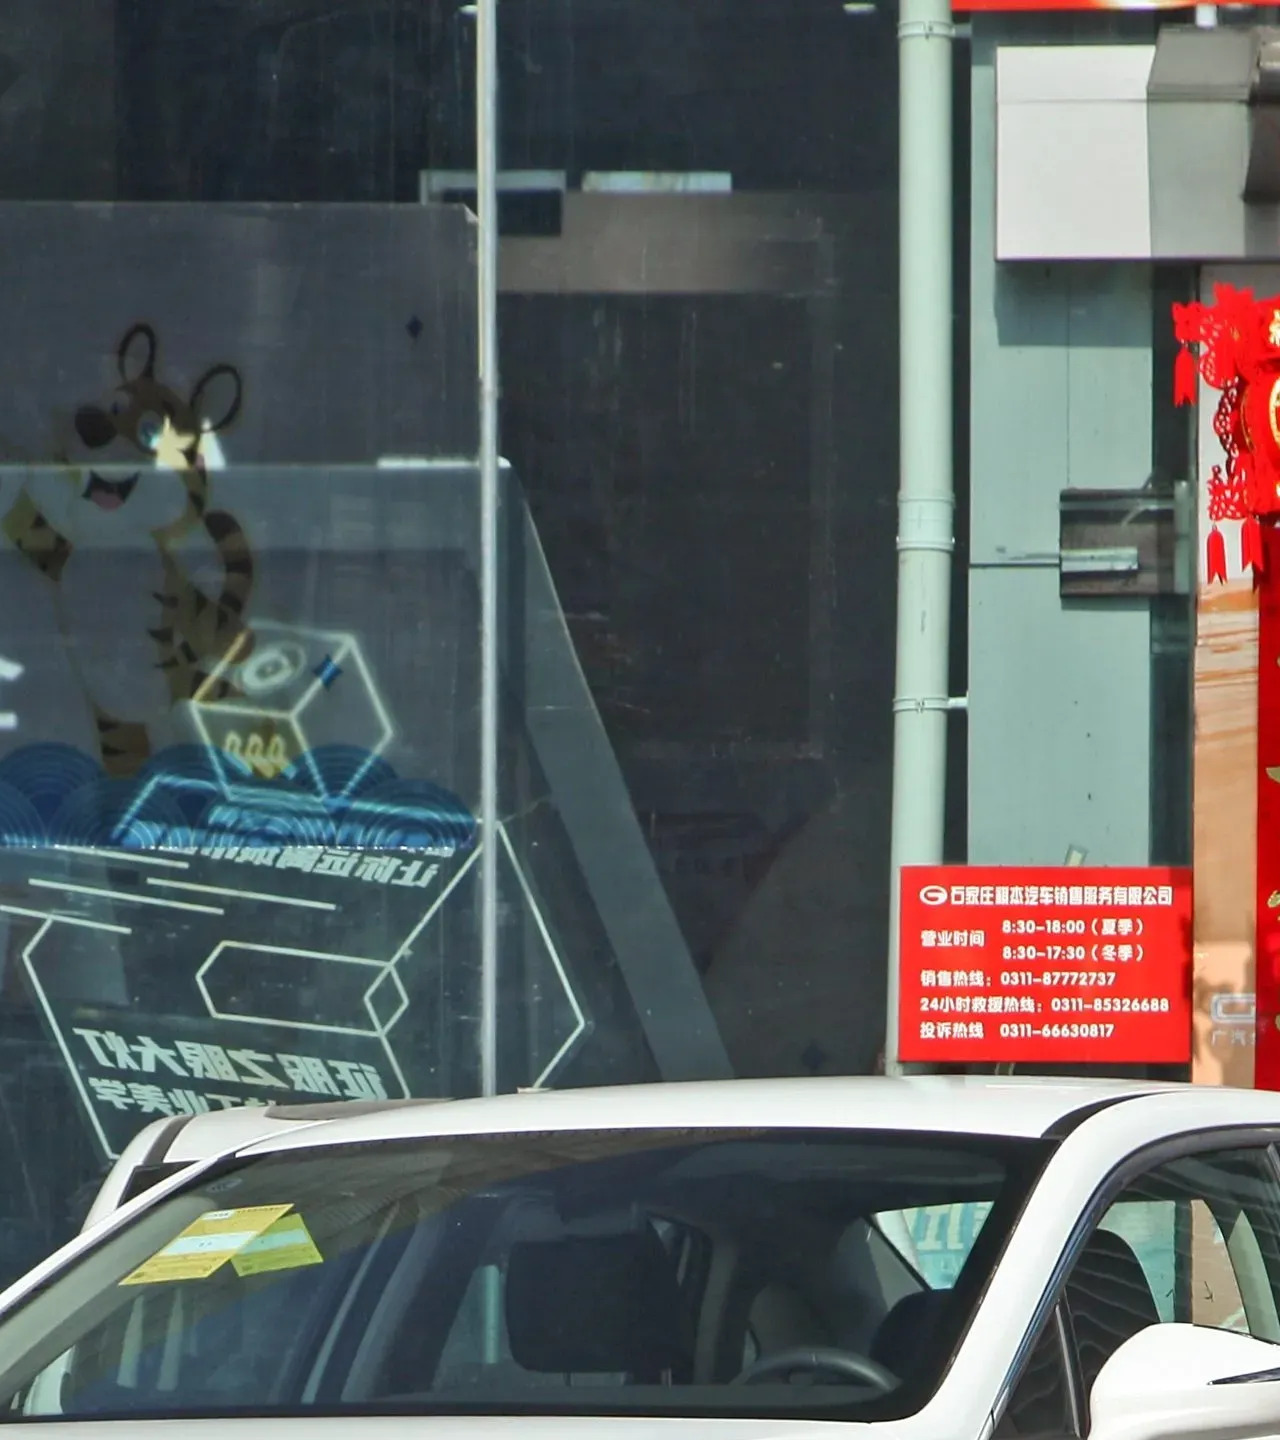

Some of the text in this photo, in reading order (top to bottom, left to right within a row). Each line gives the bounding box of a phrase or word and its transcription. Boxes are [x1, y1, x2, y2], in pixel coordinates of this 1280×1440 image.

[920, 930, 986, 948] 营业时间
[919, 1021, 1116, 1040] 投诉热线 0311-66630817
